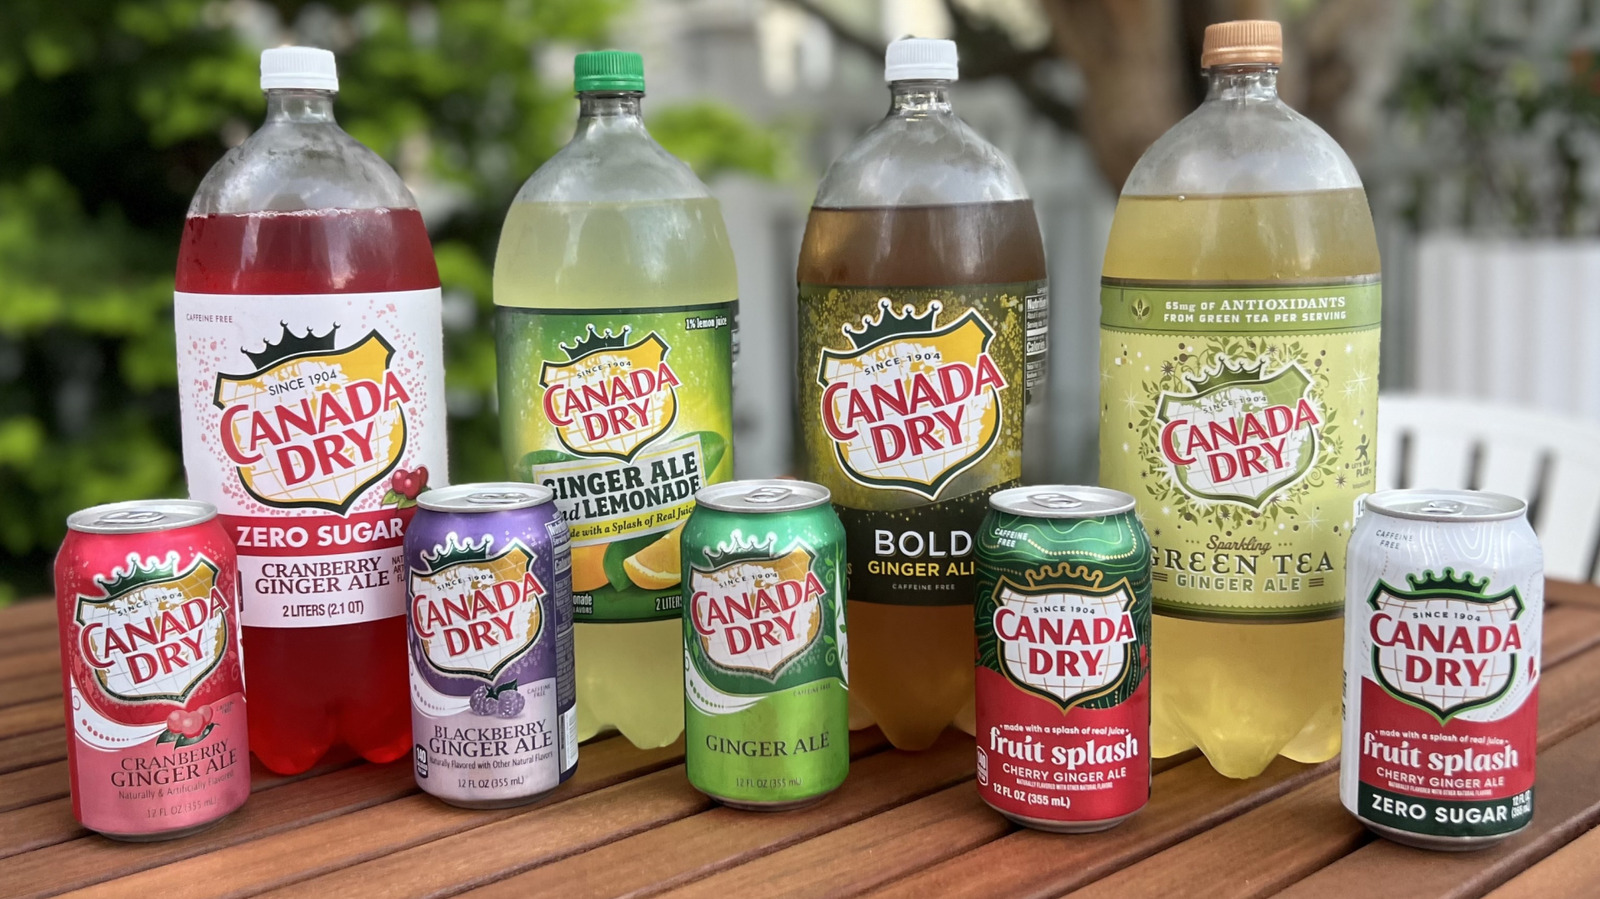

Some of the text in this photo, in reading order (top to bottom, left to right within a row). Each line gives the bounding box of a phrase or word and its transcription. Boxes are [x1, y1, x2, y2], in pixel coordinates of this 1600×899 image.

[1164, 311, 1347, 323] FROM GREEN TEA PER SERVING
[1165, 296, 1346, 313] 65mg OF ANTIOXIDANTS
[186, 313, 233, 323] CAFFEINE FREE
[686, 315, 727, 329] 1% lemon juice
[576, 360, 632, 379] SINCE 1904
[864, 351, 941, 376] SINCE 1904
[269, 372, 337, 396] SINCE 1904
[543, 362, 679, 427] CANADA
[822, 354, 1005, 441] CANADA
[1203, 396, 1267, 414] SINCE 1904
[220, 371, 411, 465] CANADA
[582, 398, 650, 442] DRY
[870, 404, 965, 464] DRY
[1161, 398, 1319, 466] CANADA
[277, 421, 374, 486] DRY
[1206, 437, 1287, 483] DRY
[543, 451, 698, 500] GINGER ALE
[561, 474, 701, 522] nd LEMONADE
[236, 518, 404, 547] ZERO SUGAR
[570, 528, 580, 538] de
[581, 525, 602, 537] with
[612, 517, 643, 534] Splash
[644, 515, 655, 527] of
[656, 509, 676, 523] Real
[994, 528, 1029, 541] CAFFEINE
[1376, 529, 1413, 541] CAFFEINE
[875, 529, 972, 557] BOLD
[997, 538, 1016, 548] FREE
[1206, 534, 1272, 555] Sparkling
[1380, 539, 1400, 550] FREE
[261, 556, 382, 578] CRANBERRY
[867, 560, 940, 577] GINGER
[1150, 546, 1334, 575] GREEN TEA
[255, 571, 390, 595] GINGER ALE
[437, 573, 494, 592] SINCE 1904
[718, 572, 778, 588] SINCE 1904
[1177, 574, 1301, 592] GINGER ALE
[117, 592, 182, 616] SINCE 1904
[282, 600, 364, 618] 2 LITERS (2.1 QT)
[412, 572, 544, 638] CANADA
[656, 598, 661, 611] 2
[691, 572, 825, 636] CANADA
[1033, 606, 1096, 615] SINCE 1904
[1413, 611, 1481, 622] SINCE 1904
[81, 589, 228, 669] CANADA
[442, 611, 515, 657] DRY
[725, 611, 797, 655] DRY
[994, 608, 1135, 646] CANADA
[1369, 613, 1522, 654] CANADA
[126, 629, 203, 685] DRY
[1029, 648, 1104, 677] DRY
[1405, 655, 1488, 687] DRY
[434, 719, 547, 742] BLACKBERRY
[1003, 724, 1024, 732] made
[1025, 725, 1042, 733] with
[1052, 725, 1080, 736] splash
[1081, 726, 1090, 735] of
[1091, 726, 1107, 735] real
[1107, 727, 1125, 736] juice
[1379, 729, 1401, 738] made
[1402, 730, 1420, 739] with
[1429, 732, 1458, 743] splash
[1459, 734, 1469, 742] of
[1470, 735, 1486, 744] real
[1486, 736, 1504, 746] juice
[121, 738, 229, 771] CRANBERRY
[429, 730, 553, 757] GINGER ALE
[706, 731, 830, 757] GINGER ALE
[989, 726, 1138, 770] fruit splash
[1363, 732, 1519, 776] fruit splash
[111, 748, 238, 787] GINGER ALE
[451, 760, 476, 769] Flavored
[477, 760, 491, 769] with
[492, 759, 510, 768] Other
[512, 755, 534, 767] Natural
[535, 751, 553, 763] Flavors
[1002, 762, 1127, 783] CHERRY GINGER ALE
[458, 779, 466, 788] 12
[468, 780, 476, 788] FL
[478, 780, 489, 788] OZ
[491, 779, 508, 790] (355
[736, 777, 744, 787] 12
[746, 778, 754, 788] FL
[756, 779, 767, 788] OZ
[769, 778, 786, 789] (355
[1376, 766, 1505, 788] CHERRY GINGER ALE
[118, 788, 155, 800] Naturally
[166, 782, 206, 796] Artificially
[993, 783, 1002, 794] 12
[1003, 786, 1013, 798] FL
[1014, 789, 1026, 802] OZ
[1028, 792, 1049, 806] (355
[1051, 796, 1071, 809] mL)
[1371, 794, 1508, 824] ZERO SUGAR
